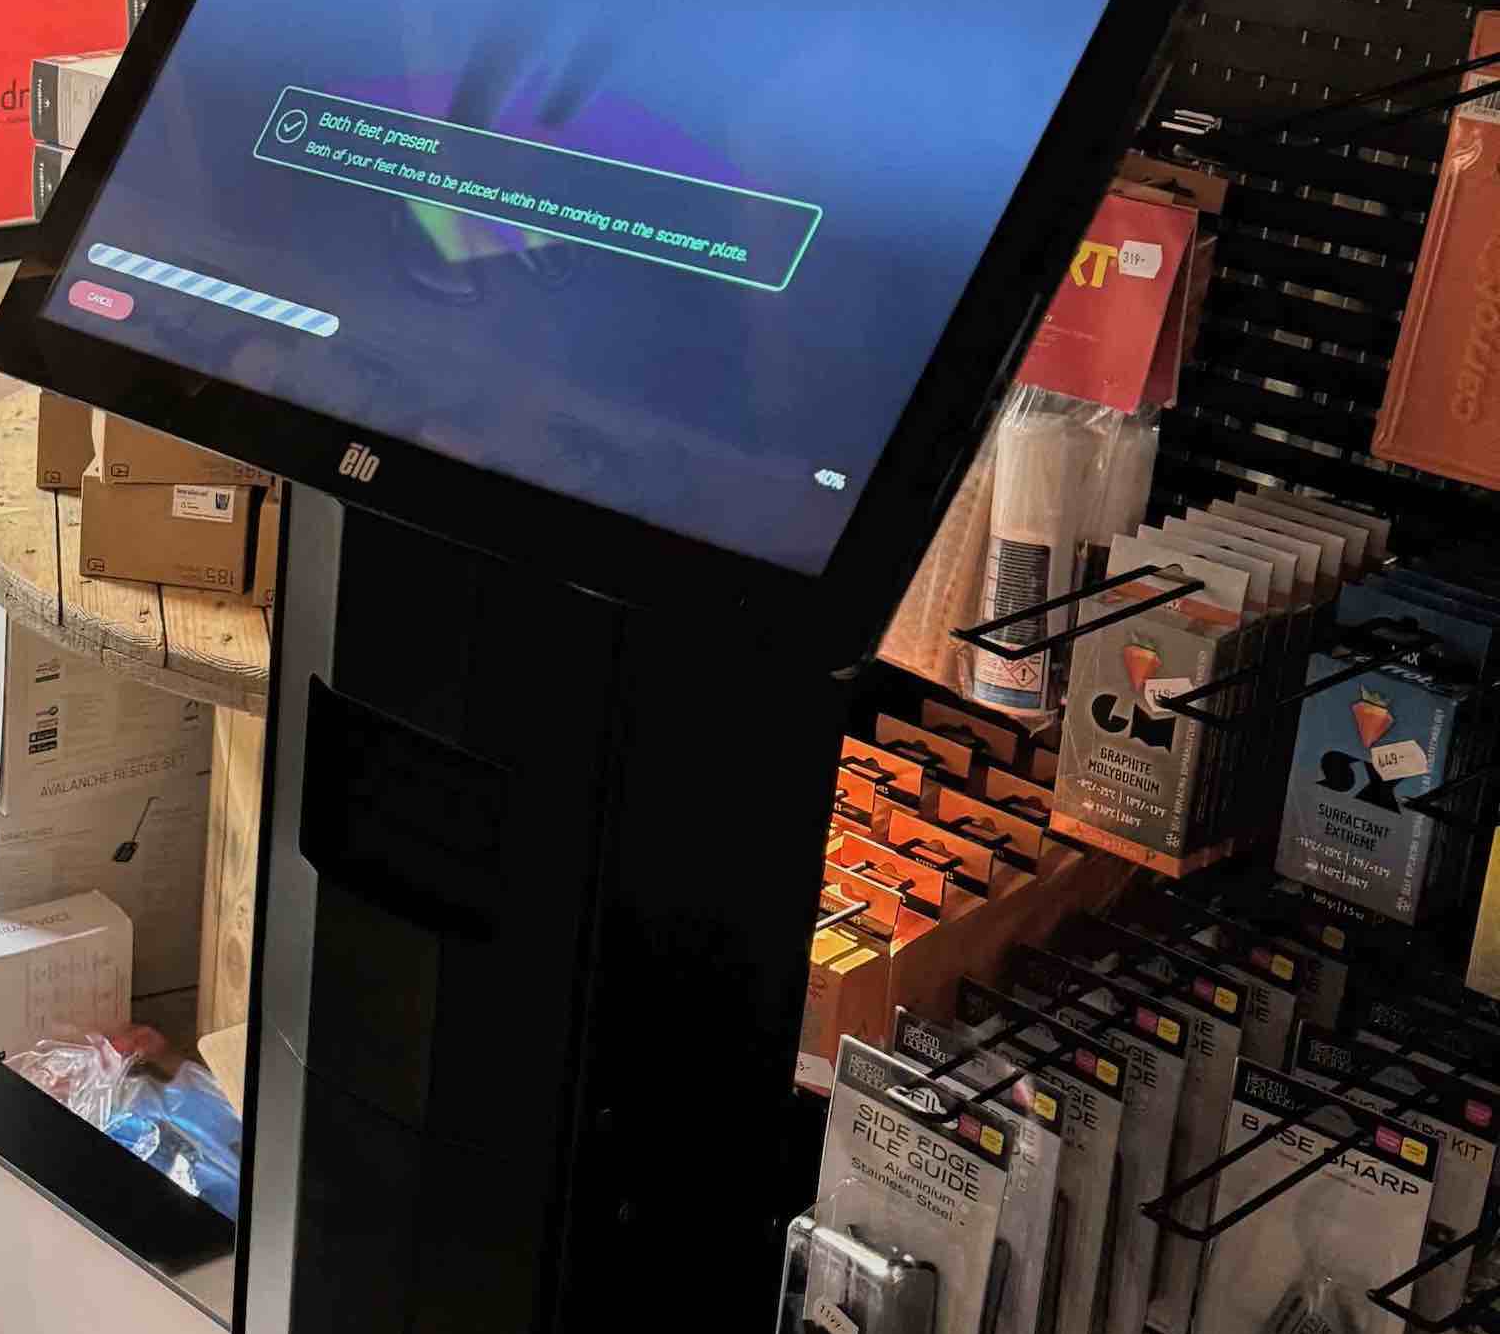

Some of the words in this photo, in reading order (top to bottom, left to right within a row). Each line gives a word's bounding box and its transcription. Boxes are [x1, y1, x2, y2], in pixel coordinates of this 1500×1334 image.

[318, 112, 351, 132] Both
[352, 119, 383, 140] feet
[383, 129, 440, 155] present
[305, 141, 331, 158] Both
[332, 148, 348, 162] of
[346, 152, 372, 168] your
[373, 158, 398, 176] feet
[398, 163, 426, 182] have
[427, 171, 442, 186] to
[442, 174, 459, 190] be
[457, 179, 500, 202] placed
[500, 190, 536, 211] within
[537, 198, 559, 216] the
[560, 205, 612, 232] marking
[611, 218, 630, 234] on
[631, 221, 655, 240] the
[655, 228, 710, 253] scanner
[708, 241, 748, 263] plate.
[1087, 758, 1161, 796] MOLYBDENUM
[1099, 746, 1154, 774] GRAPHITE
[39, 772, 112, 798] AVALANCHE
[1317, 802, 1392, 841] SURFACTANT
[1323, 820, 1379, 853] EXTREME
[857, 1102, 911, 1142] SIDE
[916, 1133, 981, 1182] EDGE
[1241, 1112, 1317, 1157] BSE
[1451, 1135, 1484, 1162] KIT
[852, 1119, 902, 1160] FILE
[907, 1149, 982, 1204] GUIDE
[850, 1156, 913, 1199] Stainless
[916, 1192, 954, 1222] Steel
[884, 1160, 957, 1208] Aluminium
